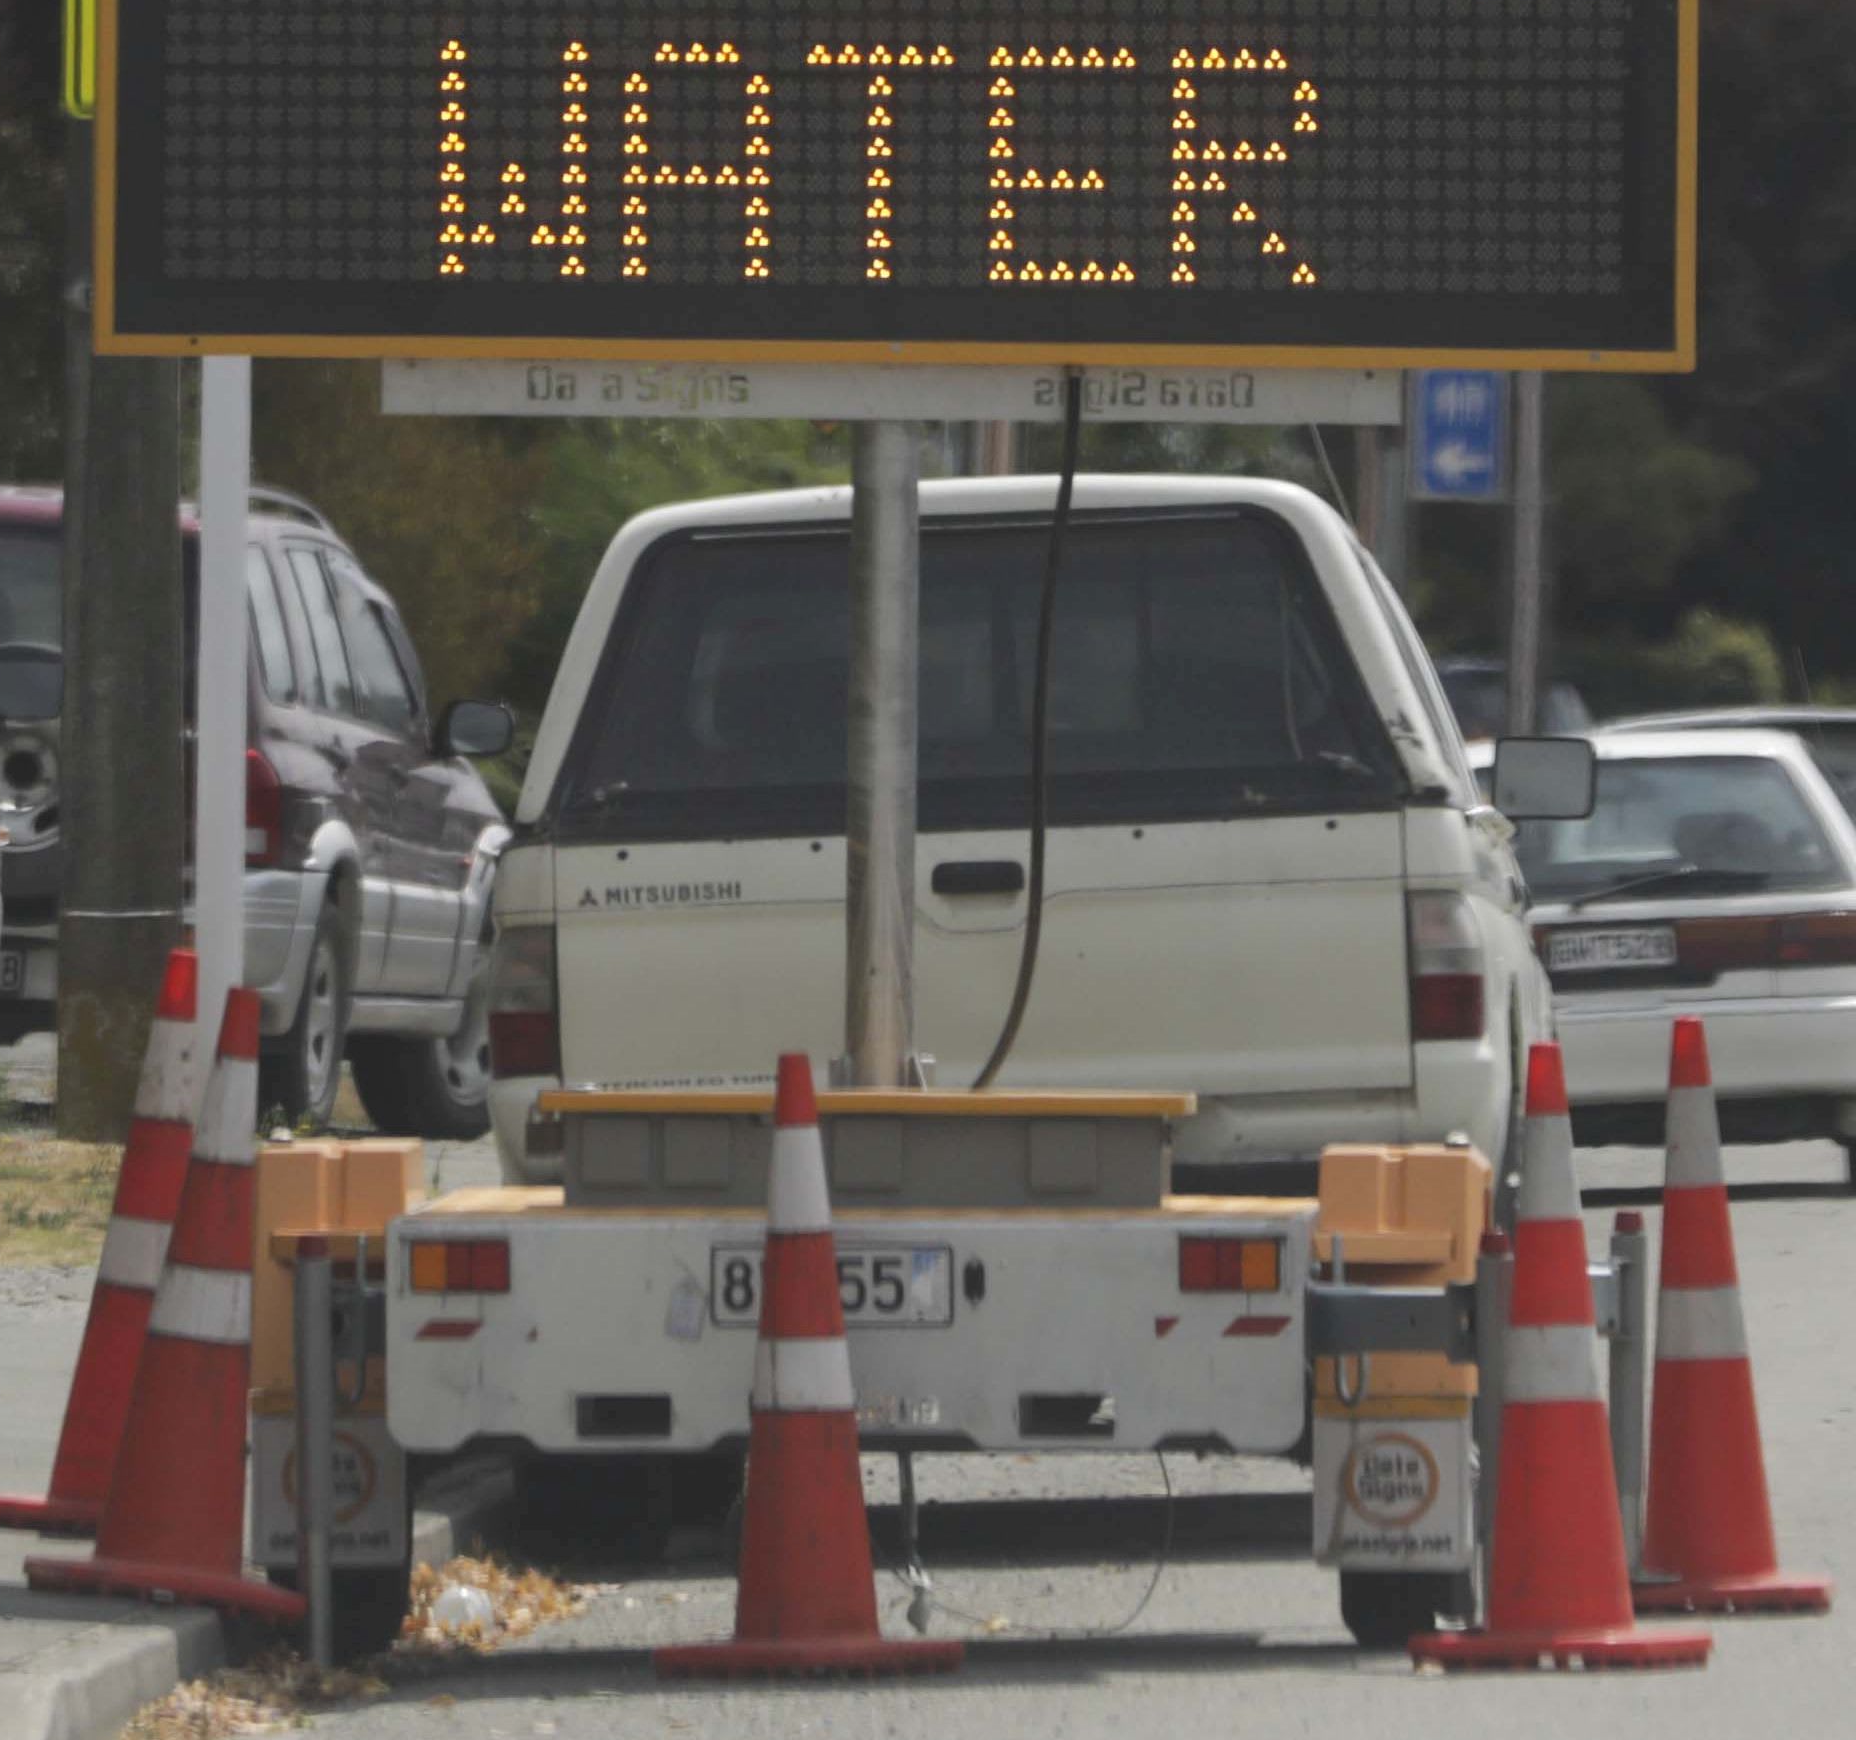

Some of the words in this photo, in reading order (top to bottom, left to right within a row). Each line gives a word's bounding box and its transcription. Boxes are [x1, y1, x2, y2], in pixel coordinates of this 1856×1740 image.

[438, 39, 1318, 285] WATER
[605, 882, 741, 905] MITSUBISHI
[723, 1255, 904, 1313] 855
